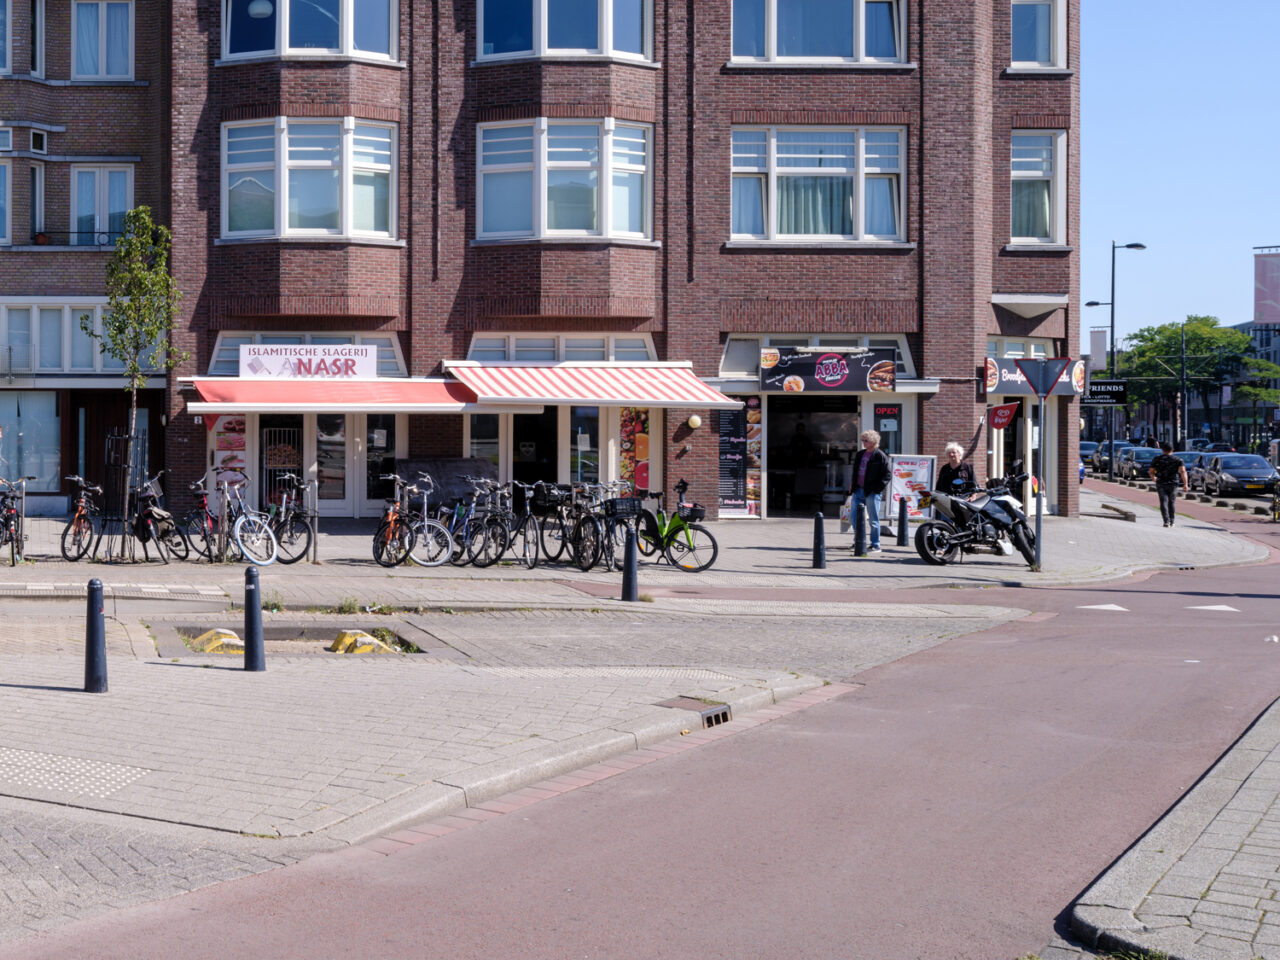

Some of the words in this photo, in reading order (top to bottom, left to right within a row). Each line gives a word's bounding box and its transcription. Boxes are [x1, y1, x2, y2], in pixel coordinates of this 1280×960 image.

[248, 347, 318, 357] ISLAMITISCHE
[322, 348, 368, 358] SLAGERIJ
[815, 360, 849, 379] ABBA
[875, 407, 898, 415] OPEN
